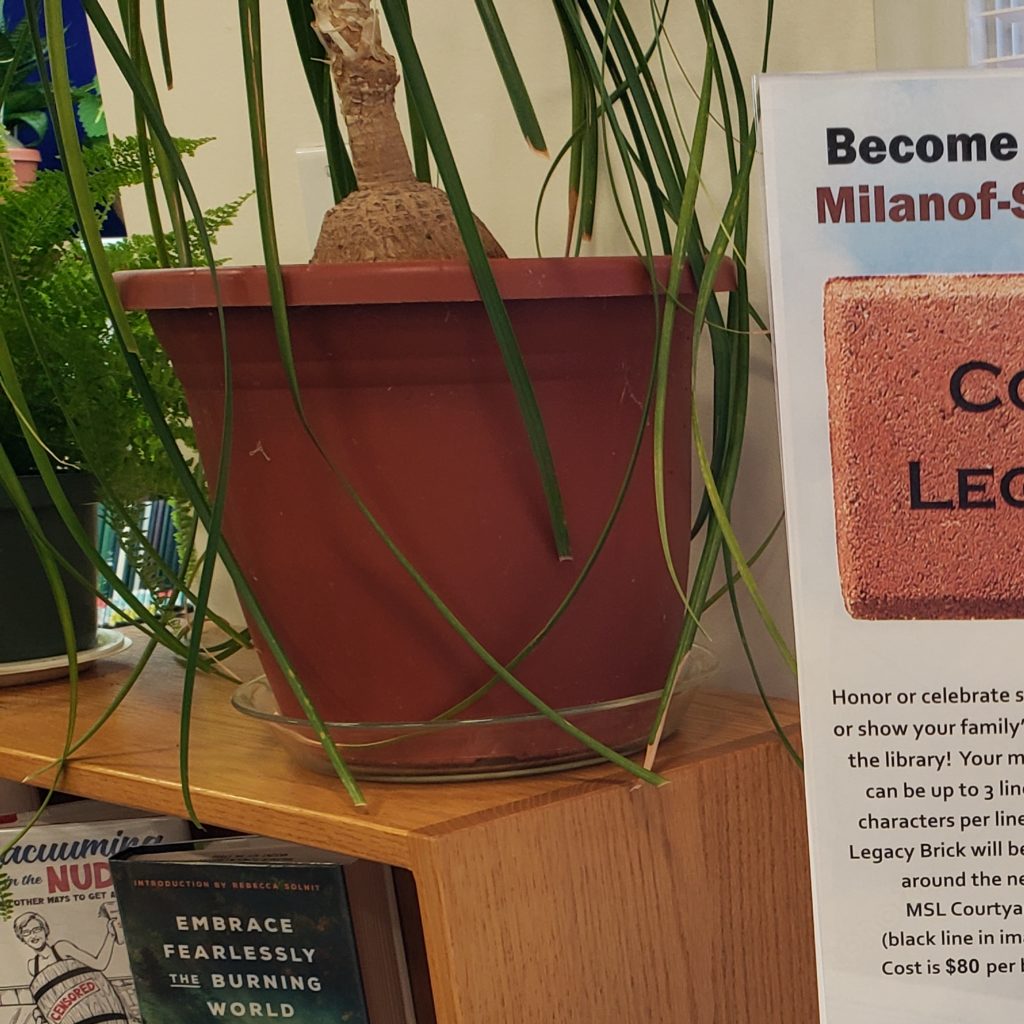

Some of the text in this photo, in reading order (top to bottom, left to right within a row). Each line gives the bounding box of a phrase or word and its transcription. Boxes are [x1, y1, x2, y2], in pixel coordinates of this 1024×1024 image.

[826, 127, 1018, 165] Become
[832, 689, 892, 705] Honor
[896, 692, 916, 704] or
[921, 686, 1009, 704] celebrate
[833, 724, 853, 736] or
[858, 719, 908, 736] show
[912, 723, 956, 740] your
[847, 752, 879, 768] the
[885, 751, 950, 771] library!
[958, 750, 1003, 766] Your
[865, 786, 897, 798] can
[903, 781, 925, 798] be
[931, 785, 954, 801] up
[958, 783, 978, 797] to
[984, 784, 993, 800] 3
[858, 813, 954, 829] characters
[960, 815, 990, 832] per
[849, 844, 914, 864] Legacy
[920, 841, 966, 858] Brick
[970, 840, 1002, 856] will
[901, 871, 965, 888] around
[970, 870, 1001, 886] the
[906, 902, 946, 917] MSL
[175, 915, 294, 934] EMBRACE
[882, 930, 936, 949] (black
[941, 930, 973, 945] line
[978, 929, 994, 944] in
[163, 943, 316, 964] FEARLESSLY
[881, 960, 922, 975] Cost
[926, 959, 940, 974] is
[945, 957, 979, 975] $80
[986, 962, 1016, 977] per
[169, 973, 322, 992] THE BURNING
[50, 978, 96, 1022] CENSORED
[206, 1001, 295, 1018] WORLD
